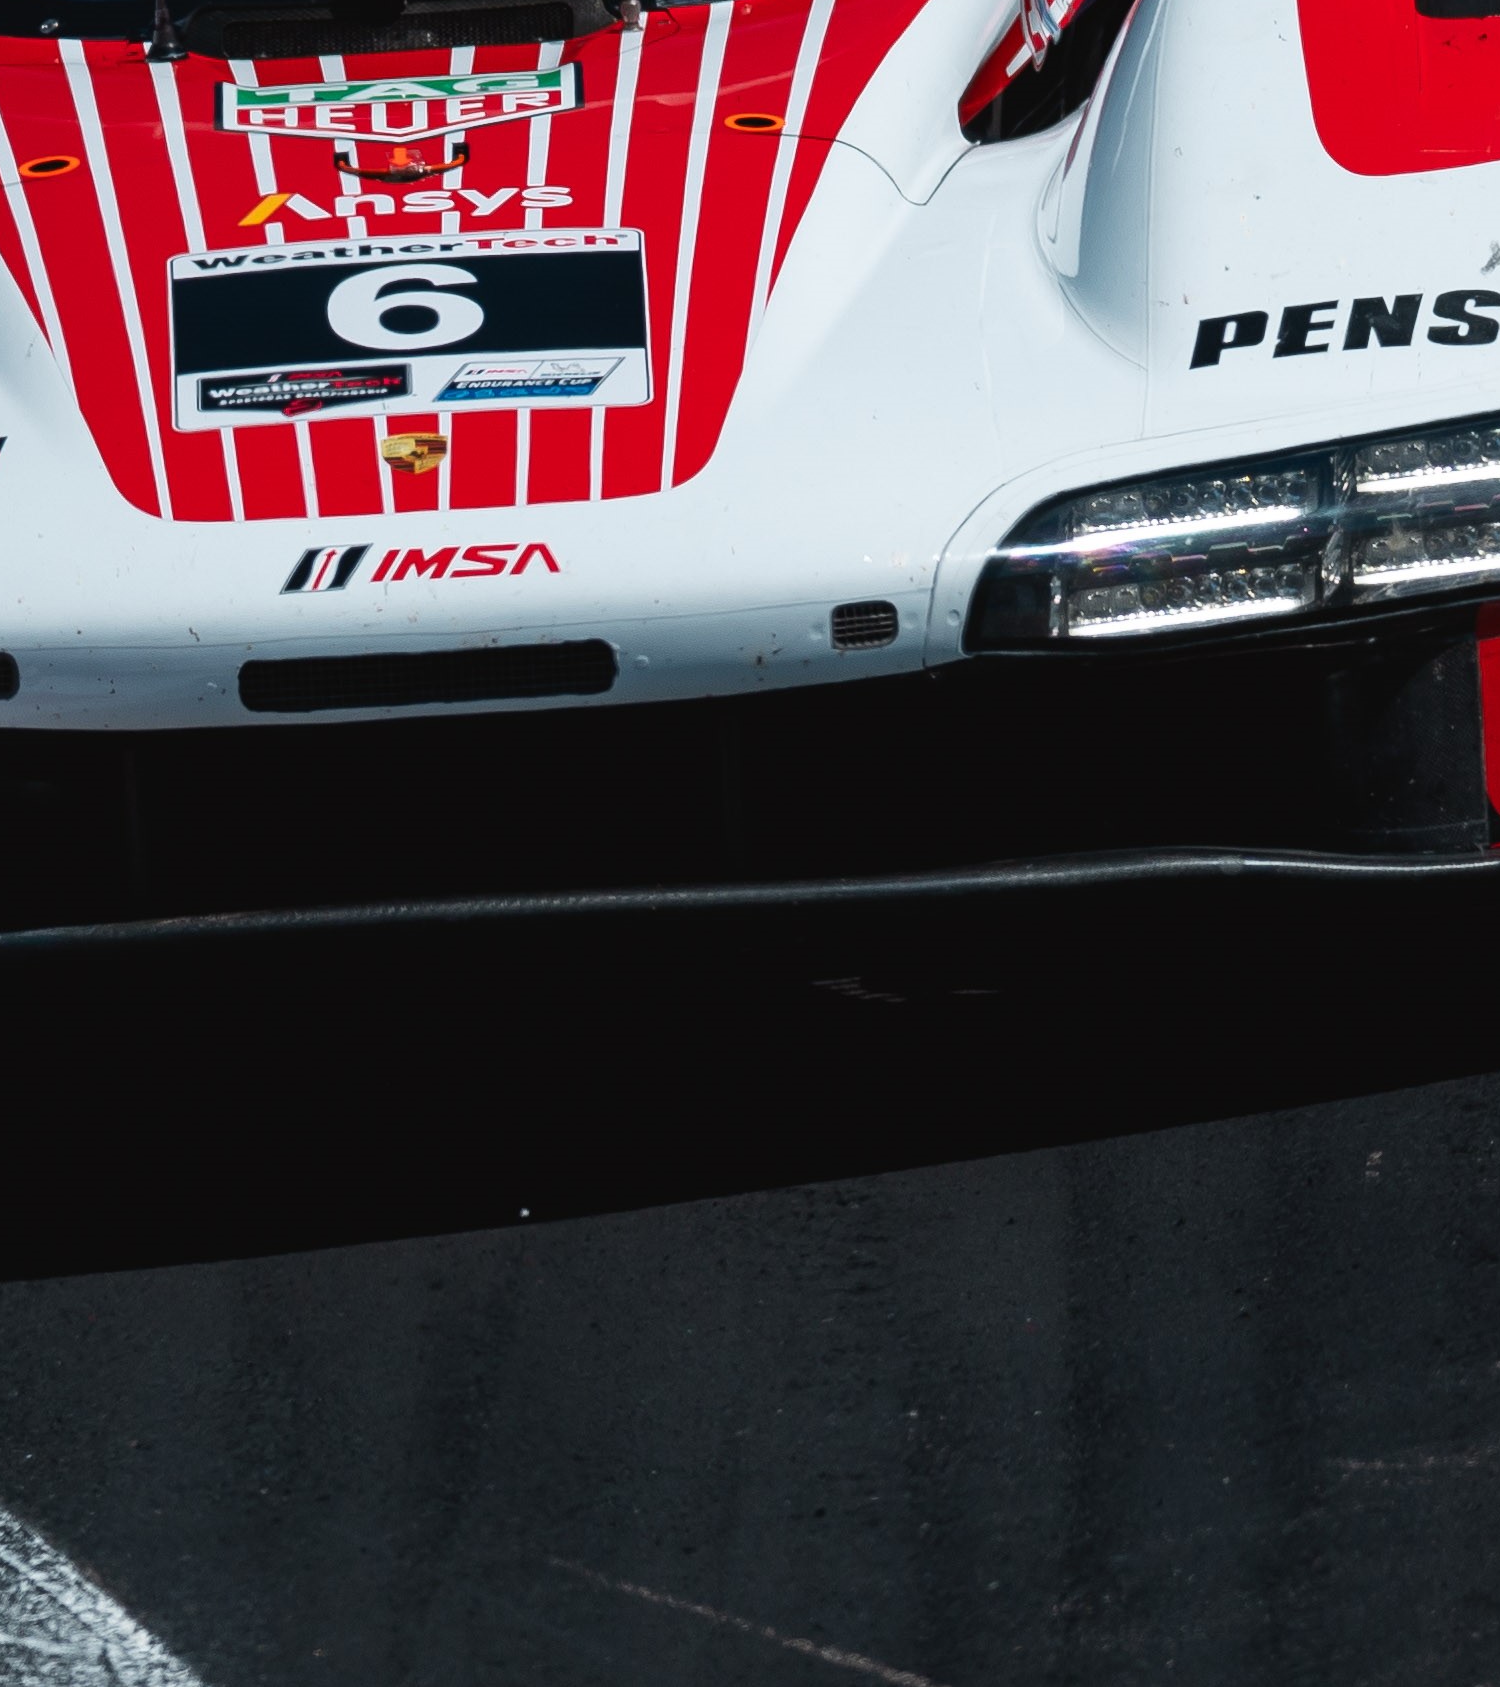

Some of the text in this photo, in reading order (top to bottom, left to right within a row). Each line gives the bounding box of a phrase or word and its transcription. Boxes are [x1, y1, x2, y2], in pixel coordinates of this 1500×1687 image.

[252, 76, 540, 102] TAG
[249, 92, 552, 135] HEUER
[238, 185, 574, 226] Ansys
[192, 234, 620, 271] WeatherTech
[326, 262, 485, 351] 6
[455, 377, 594, 390] ENDURANCE CUP
[369, 542, 561, 584] IMSA
